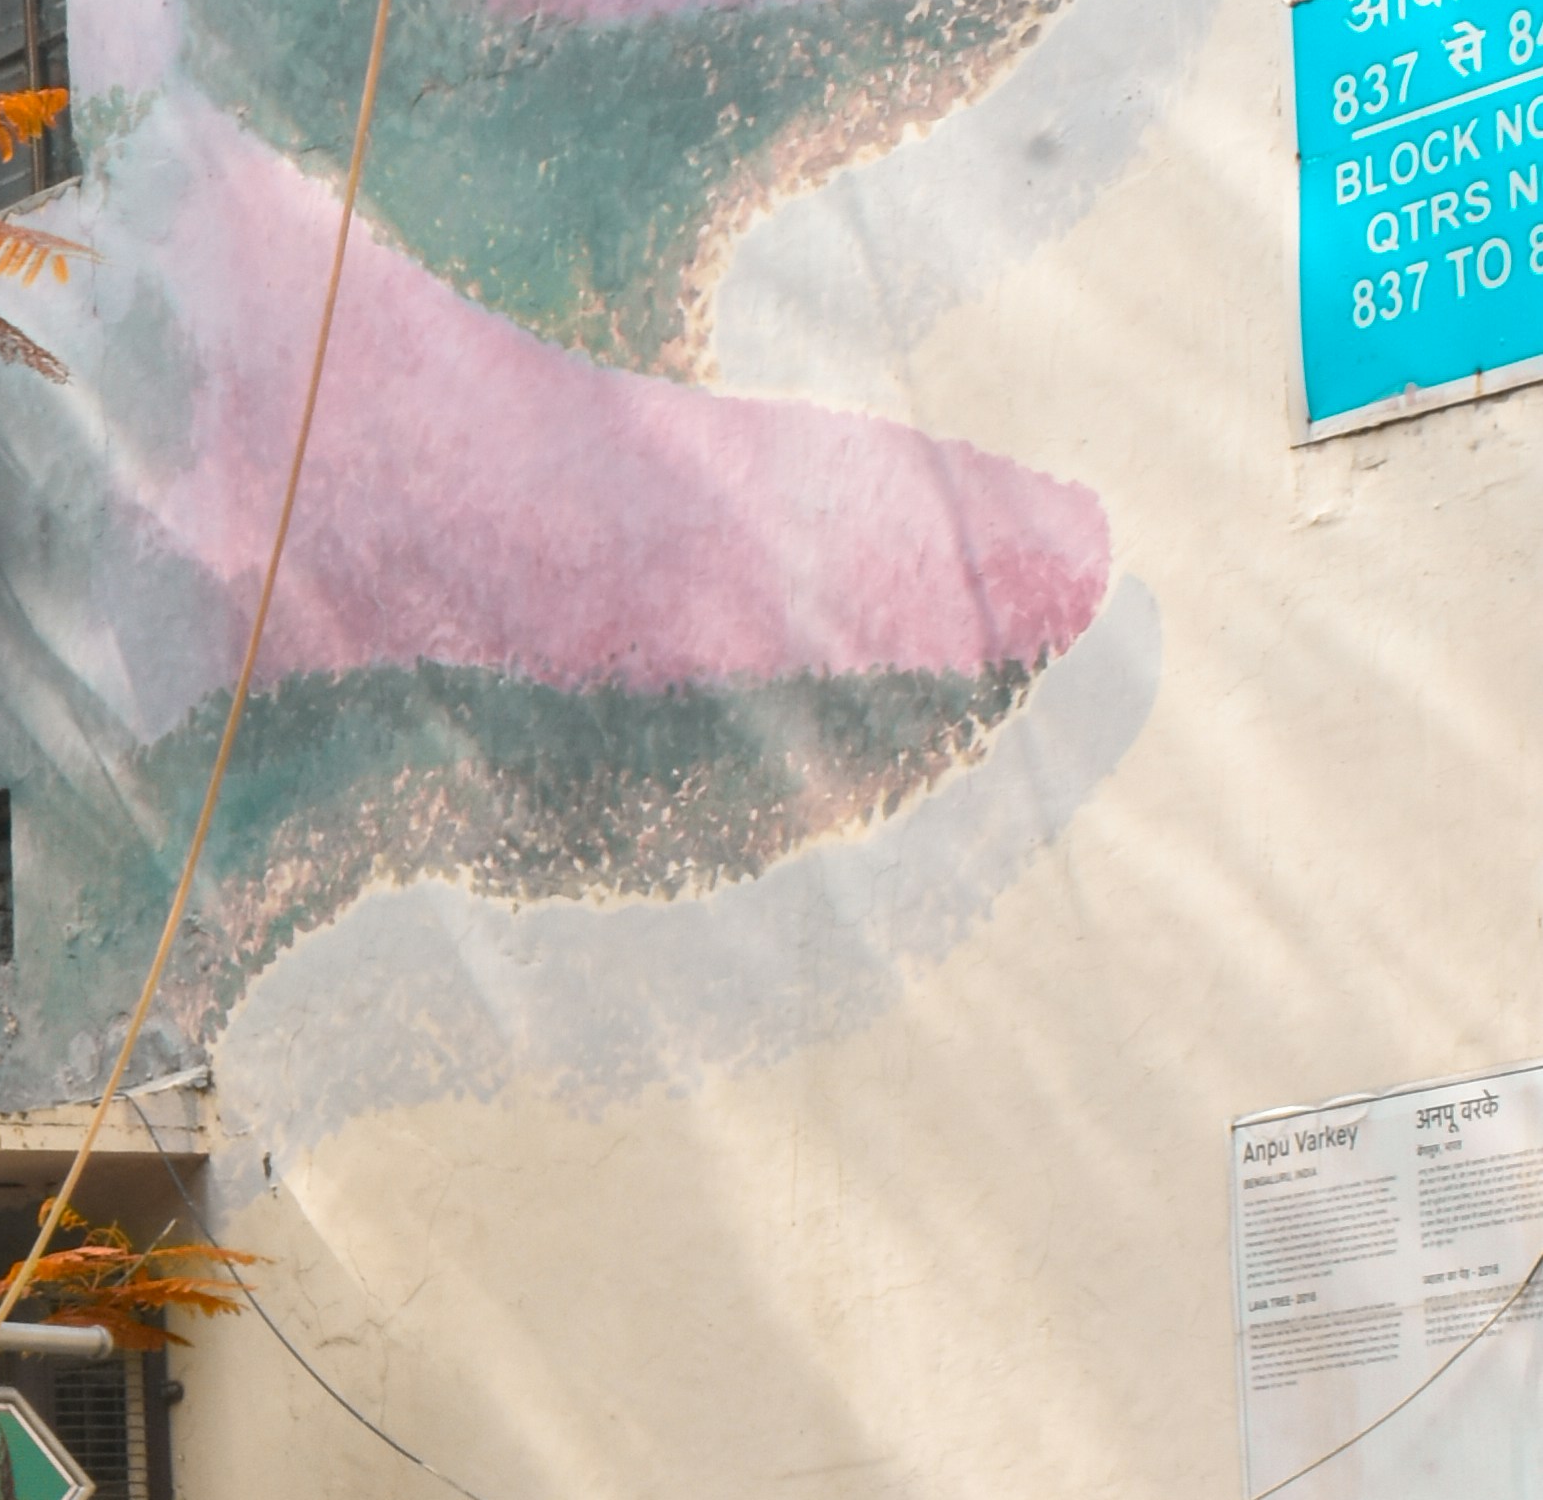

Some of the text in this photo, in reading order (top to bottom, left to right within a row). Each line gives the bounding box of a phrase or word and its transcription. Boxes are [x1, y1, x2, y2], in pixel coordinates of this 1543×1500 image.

[1333, 10, 1543, 125] 837 से 8
[1336, 118, 1481, 206] BLOCK
[1367, 164, 1543, 253] QTRS N
[1353, 261, 1429, 328] 837
[1446, 238, 1511, 298] TO
[1243, 1125, 1359, 1166] Anpu Varkey
[1416, 1089, 1499, 1133] अनपू वरके
